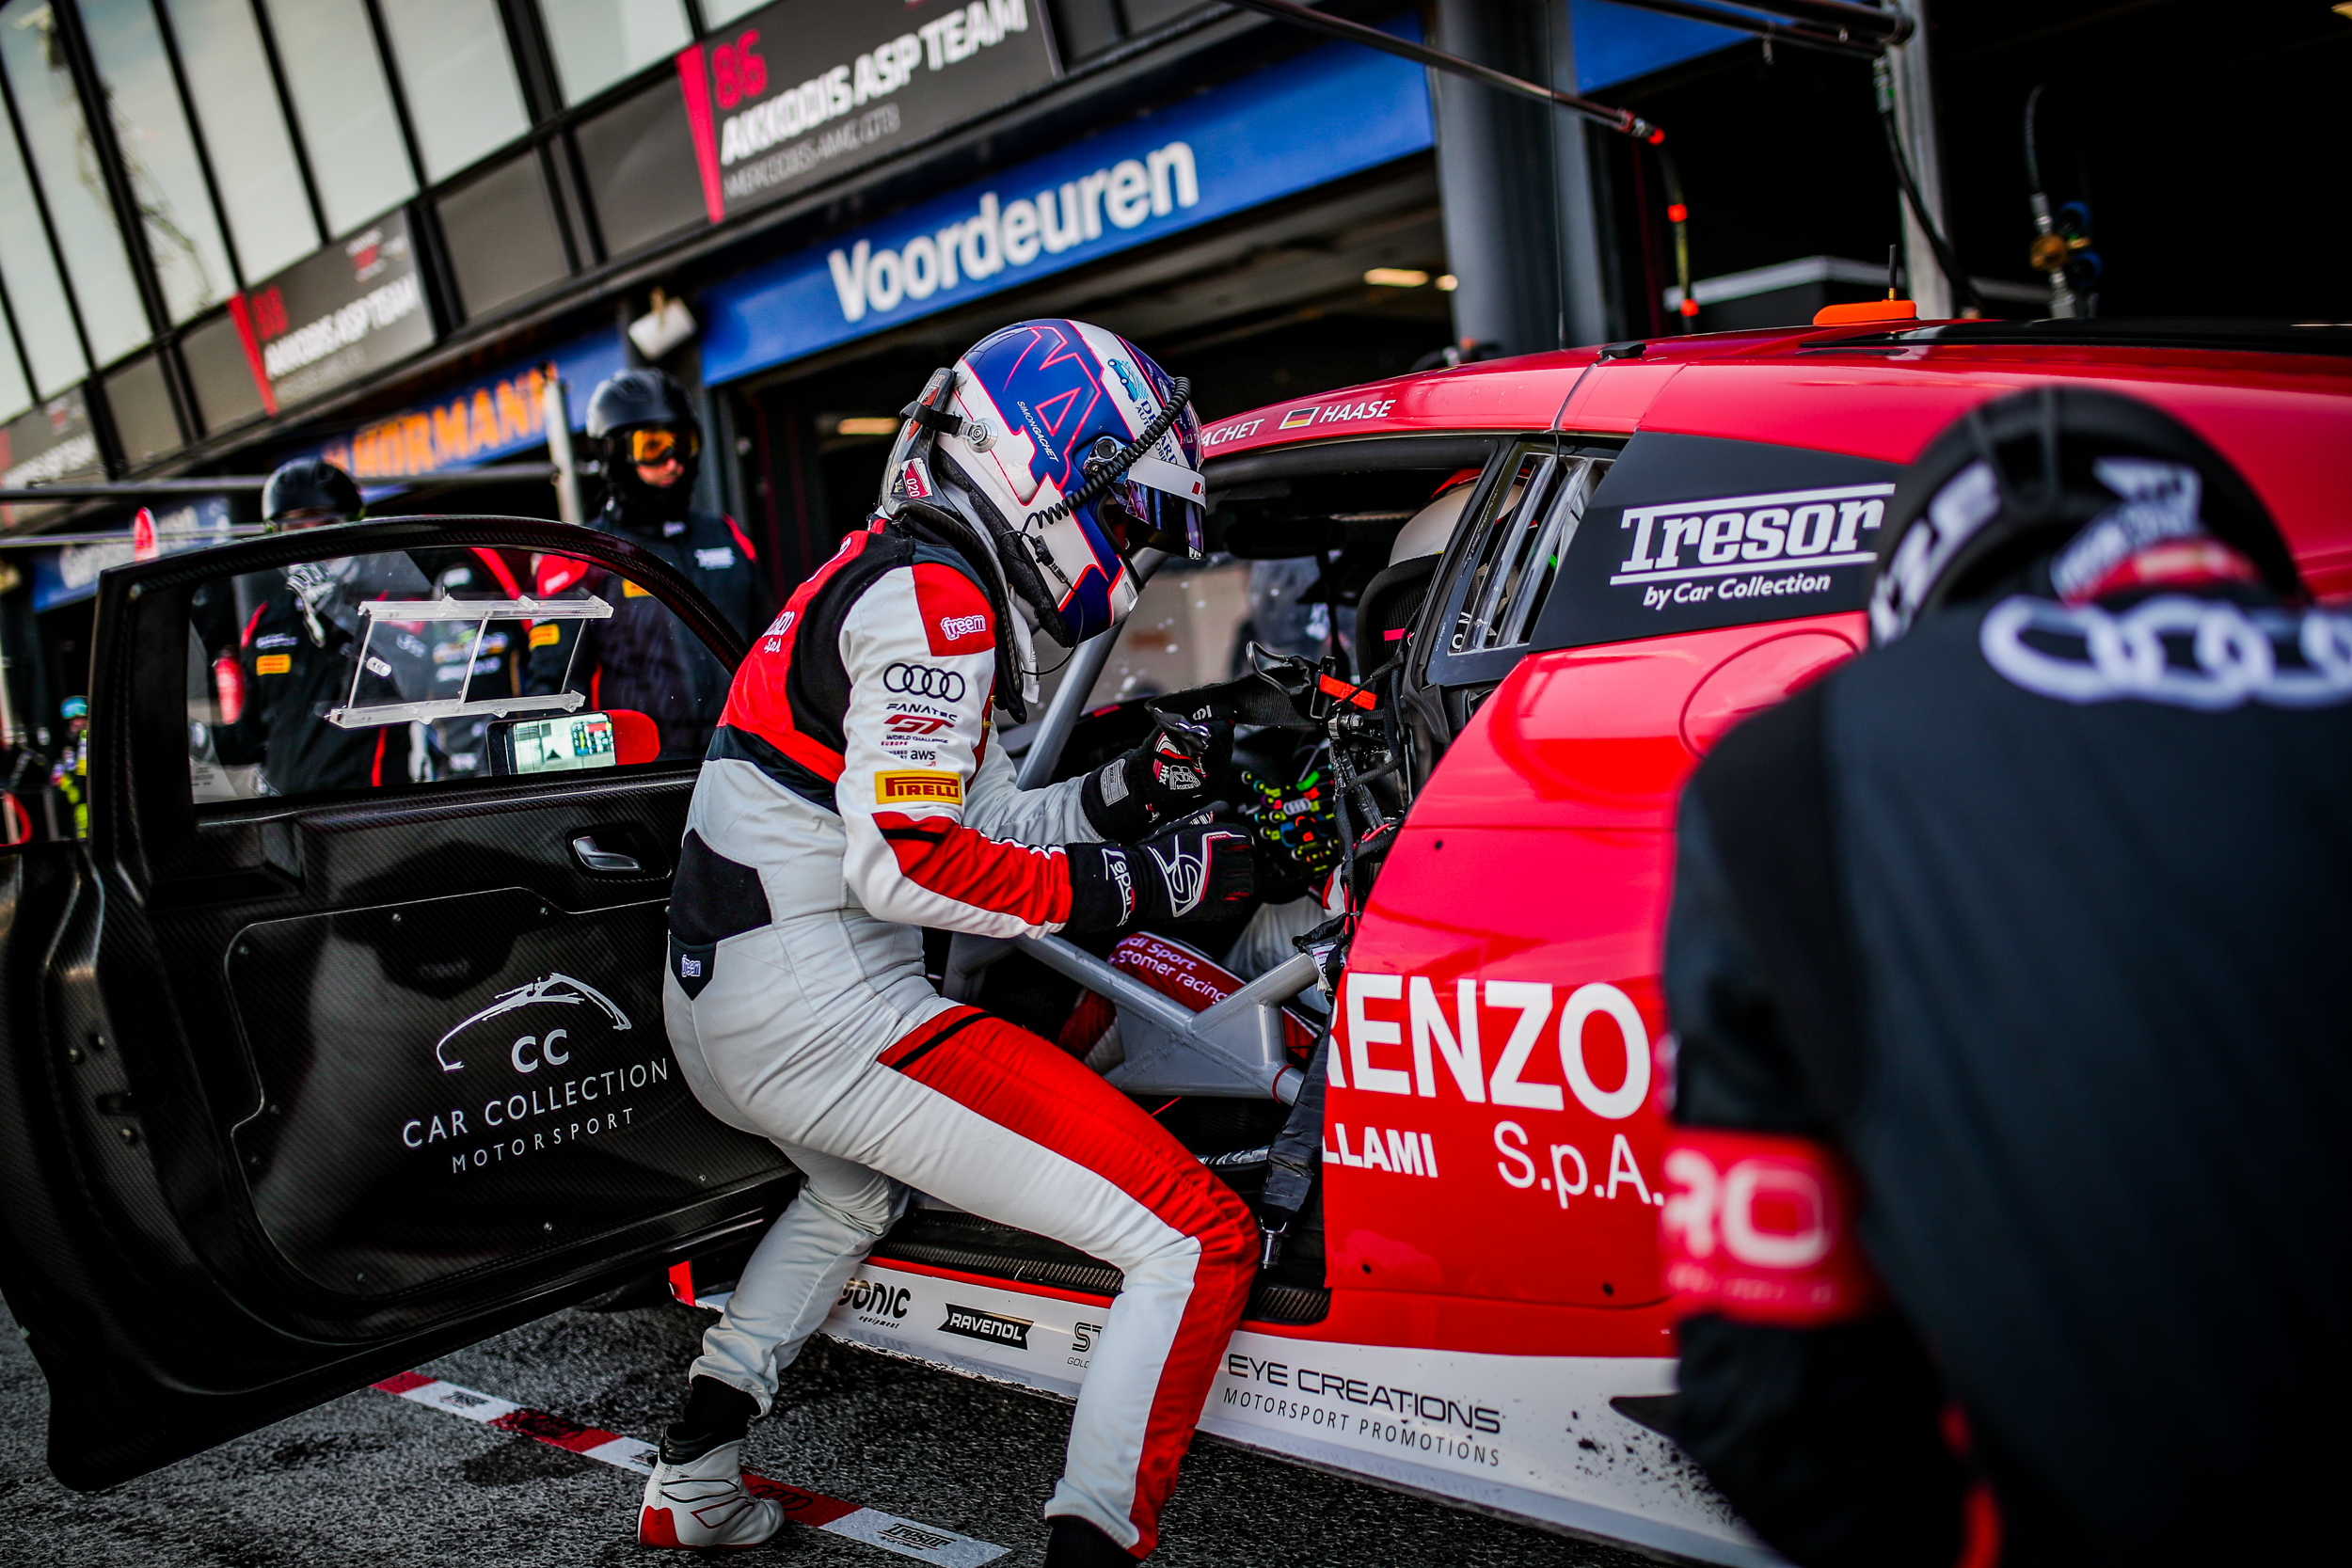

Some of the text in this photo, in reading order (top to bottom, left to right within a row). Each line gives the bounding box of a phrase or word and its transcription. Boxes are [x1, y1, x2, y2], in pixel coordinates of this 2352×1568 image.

[711, 29, 768, 109] 86
[854, 32, 922, 105] ASP
[918, 0, 1028, 71] TEAM
[828, 140, 1200, 322] Voordeuren
[1200, 400, 1397, 447] ACHET HAASE
[1620, 483, 1896, 573] Tresor
[1643, 572, 1832, 610] by Car Collection
[941, 615, 987, 641] freem
[885, 704, 958, 721] FANATEC
[910, 750, 936, 761] aws
[885, 776, 959, 799] PIRELLI
[1108, 949, 1177, 976] stomer
[1147, 942, 1198, 971] Sport
[510, 1029, 570, 1073] CC
[402, 1057, 669, 1149] CAR COLLECTION
[452, 1107, 634, 1175] MOTORSPORT
[948, 1313, 1025, 1342] RAVENOL
[1227, 1353, 1502, 1434] EYE CREATIONS
[1223, 1386, 1500, 1467] MOTORSPORT PROMOTIONS
